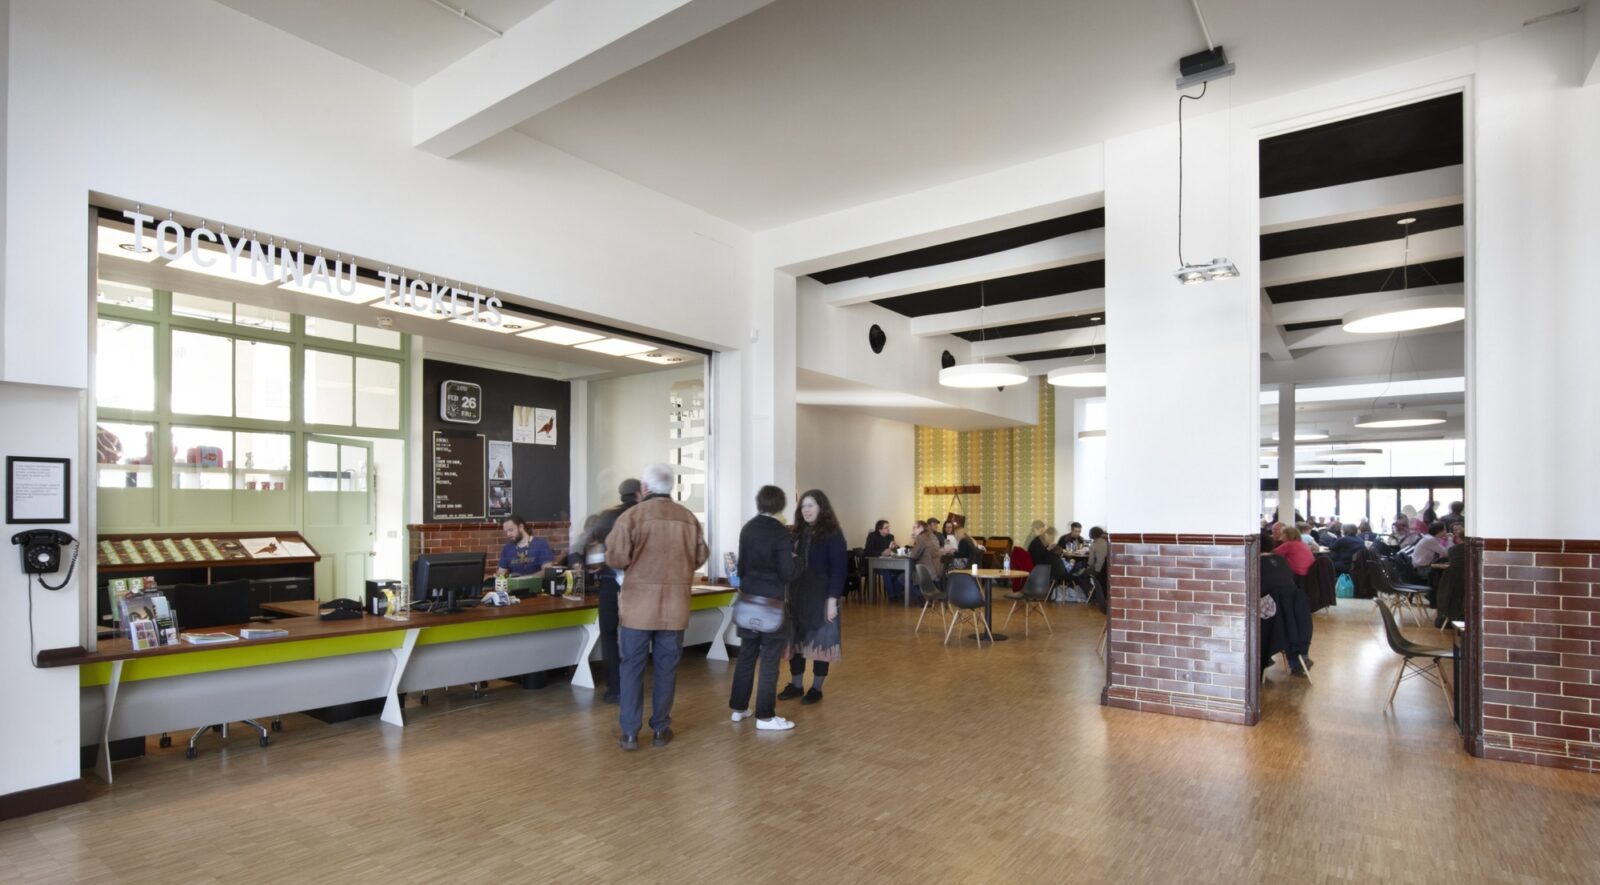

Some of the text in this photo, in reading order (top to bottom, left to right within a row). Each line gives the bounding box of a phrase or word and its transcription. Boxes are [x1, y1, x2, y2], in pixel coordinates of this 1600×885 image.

[123, 209, 503, 327] TOCYNNAU TICKETS
[461, 396, 477, 409] 26
